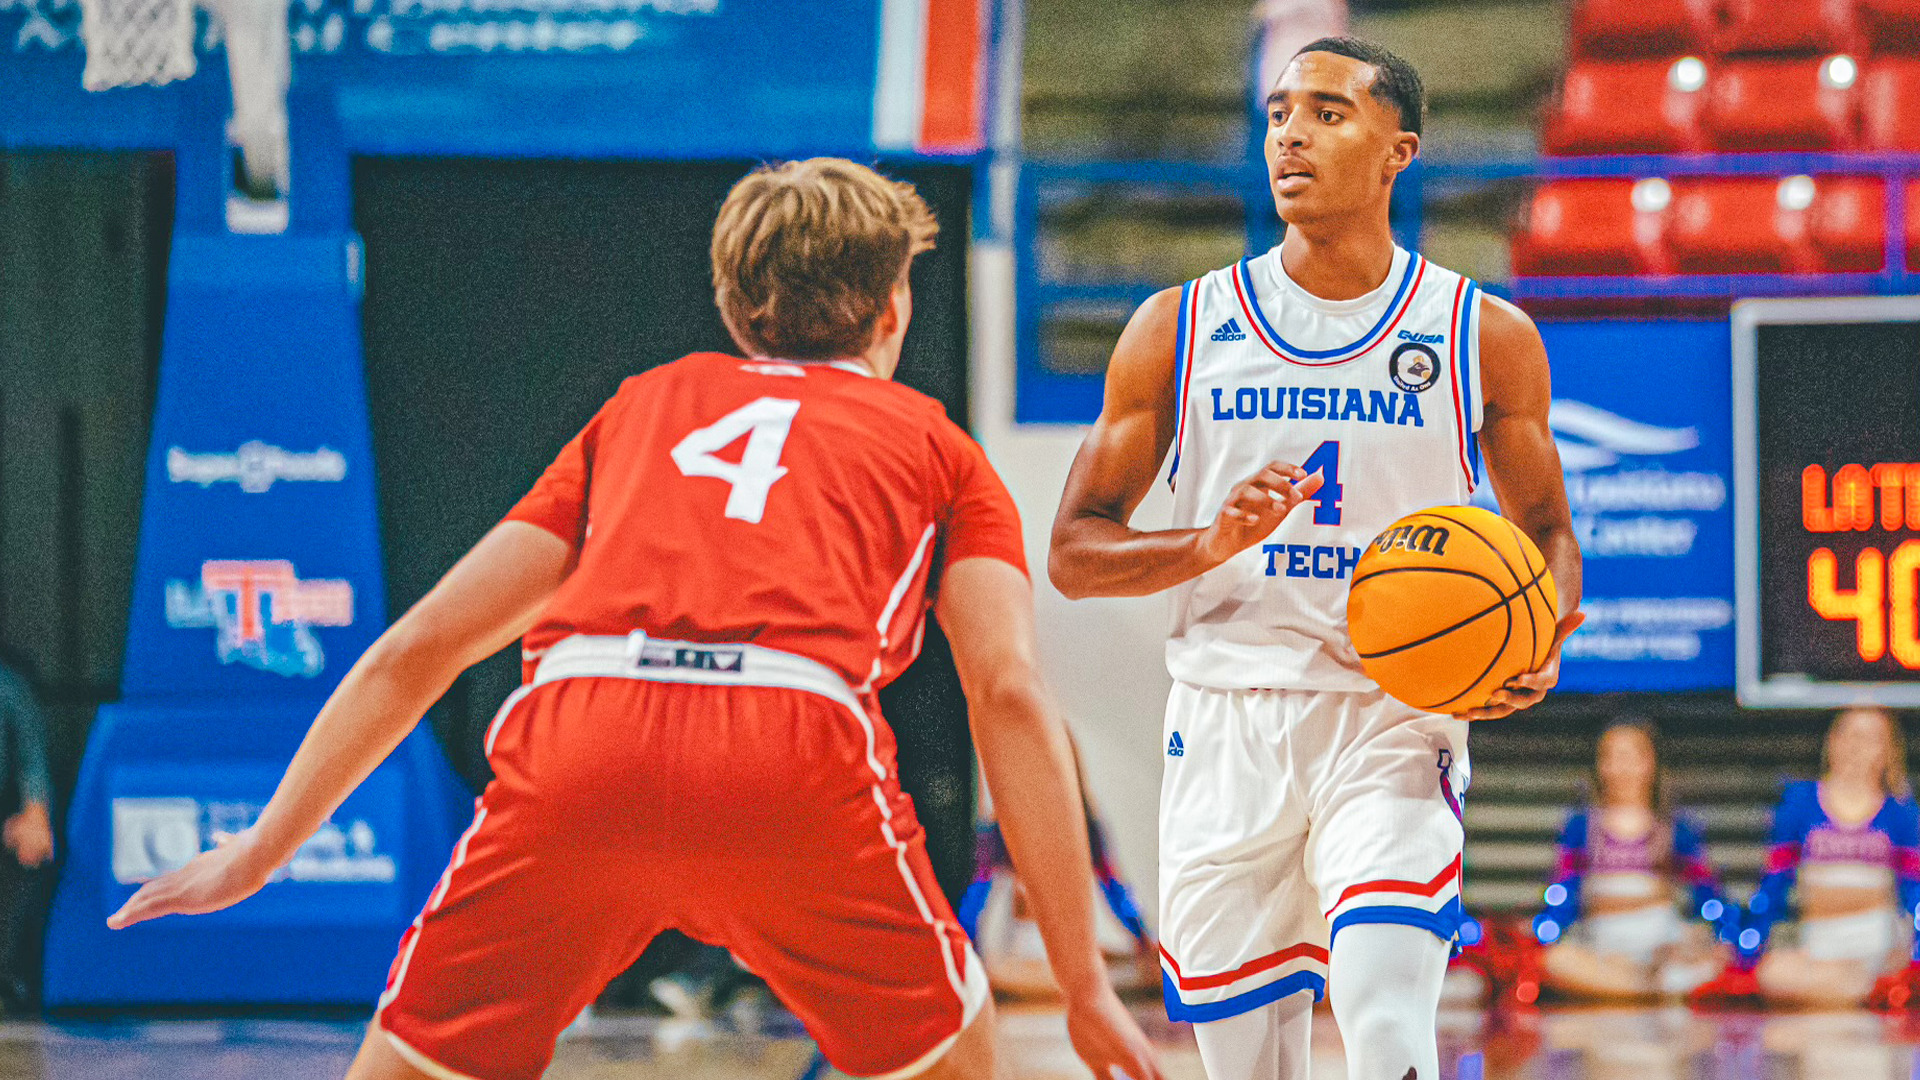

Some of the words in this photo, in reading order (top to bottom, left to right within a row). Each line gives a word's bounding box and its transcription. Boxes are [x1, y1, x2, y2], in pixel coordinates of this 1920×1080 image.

[1210, 332, 1247, 342] adidas
[1211, 387, 1425, 428] LOUISIANA
[671, 396, 801, 525] 4
[1289, 440, 1344, 527] 4
[1375, 525, 1450, 557] Wil
[1262, 543, 1362, 579] TECH
